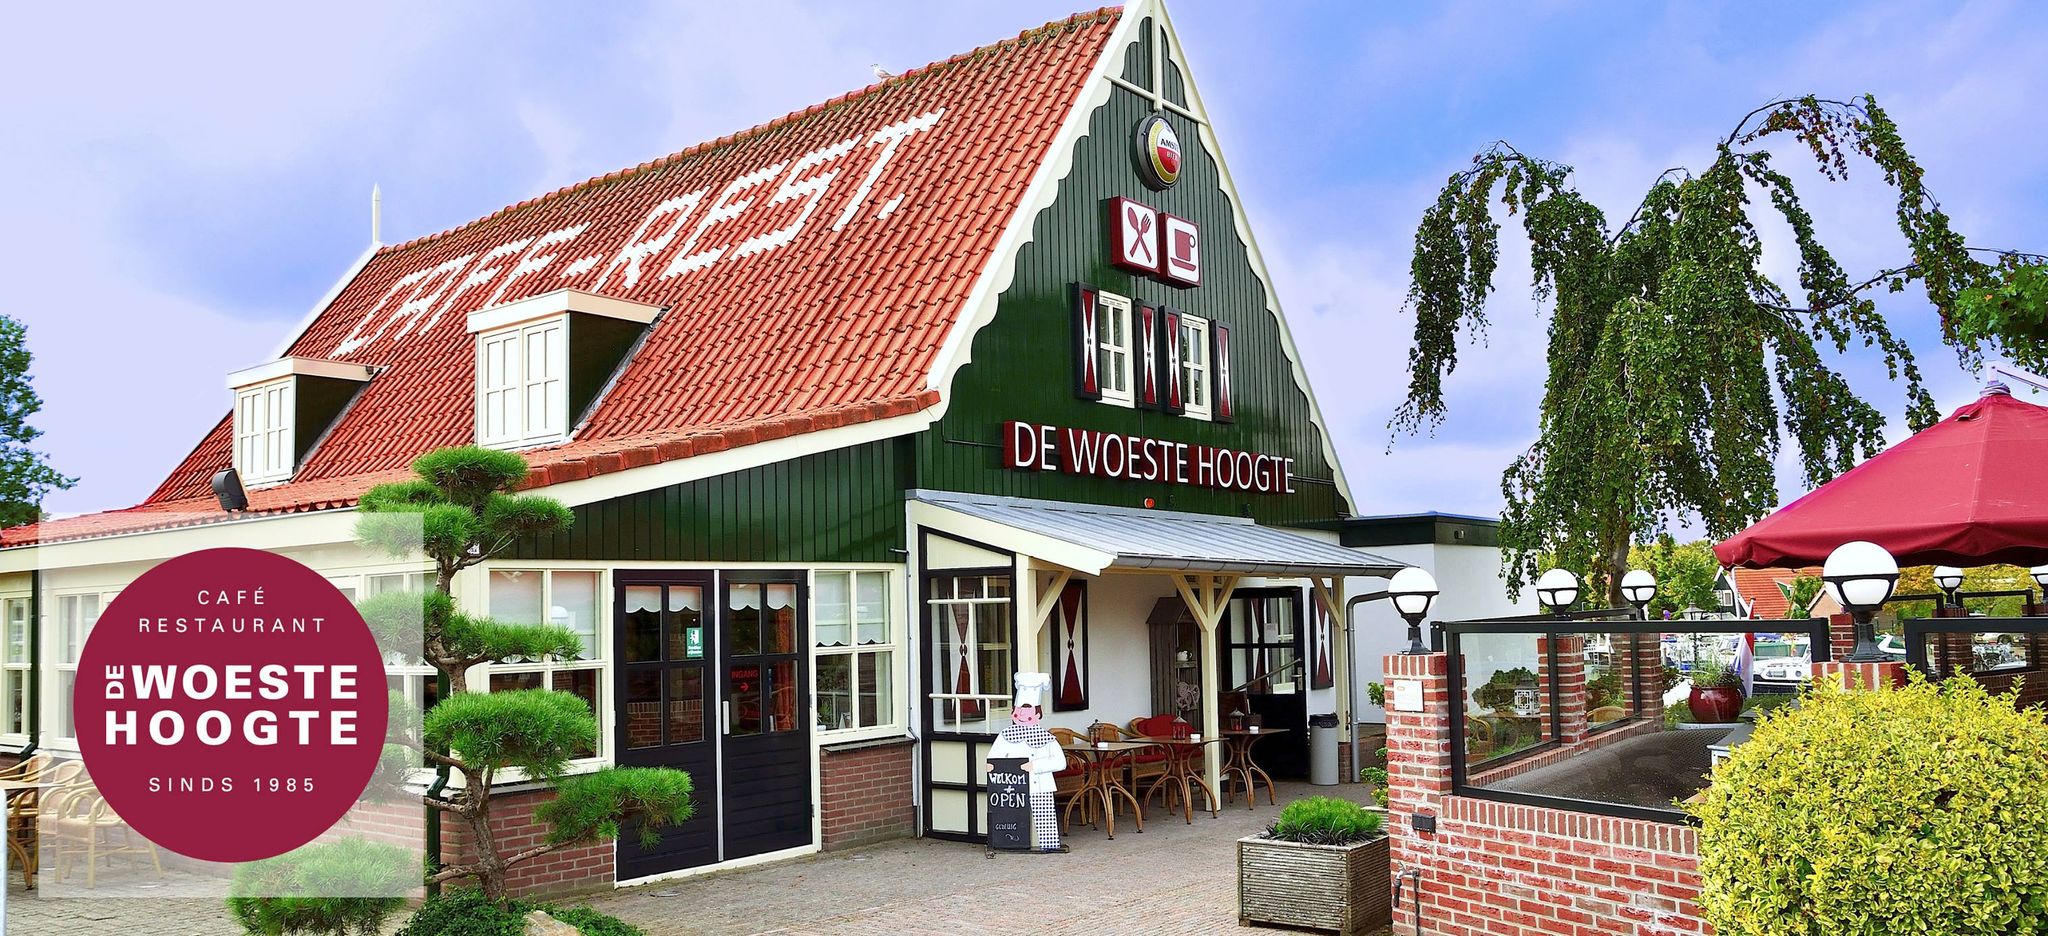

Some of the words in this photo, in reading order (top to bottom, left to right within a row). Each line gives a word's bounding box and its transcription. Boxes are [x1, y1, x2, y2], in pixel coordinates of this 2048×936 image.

[1014, 421, 1057, 471] DE
[1068, 428, 1189, 484] WOESTE
[1198, 445, 1296, 494] HOOGTE
[731, 669, 759, 679] INGANG
[988, 772, 1027, 785] WELKOM
[990, 792, 1026, 808] OPEN
